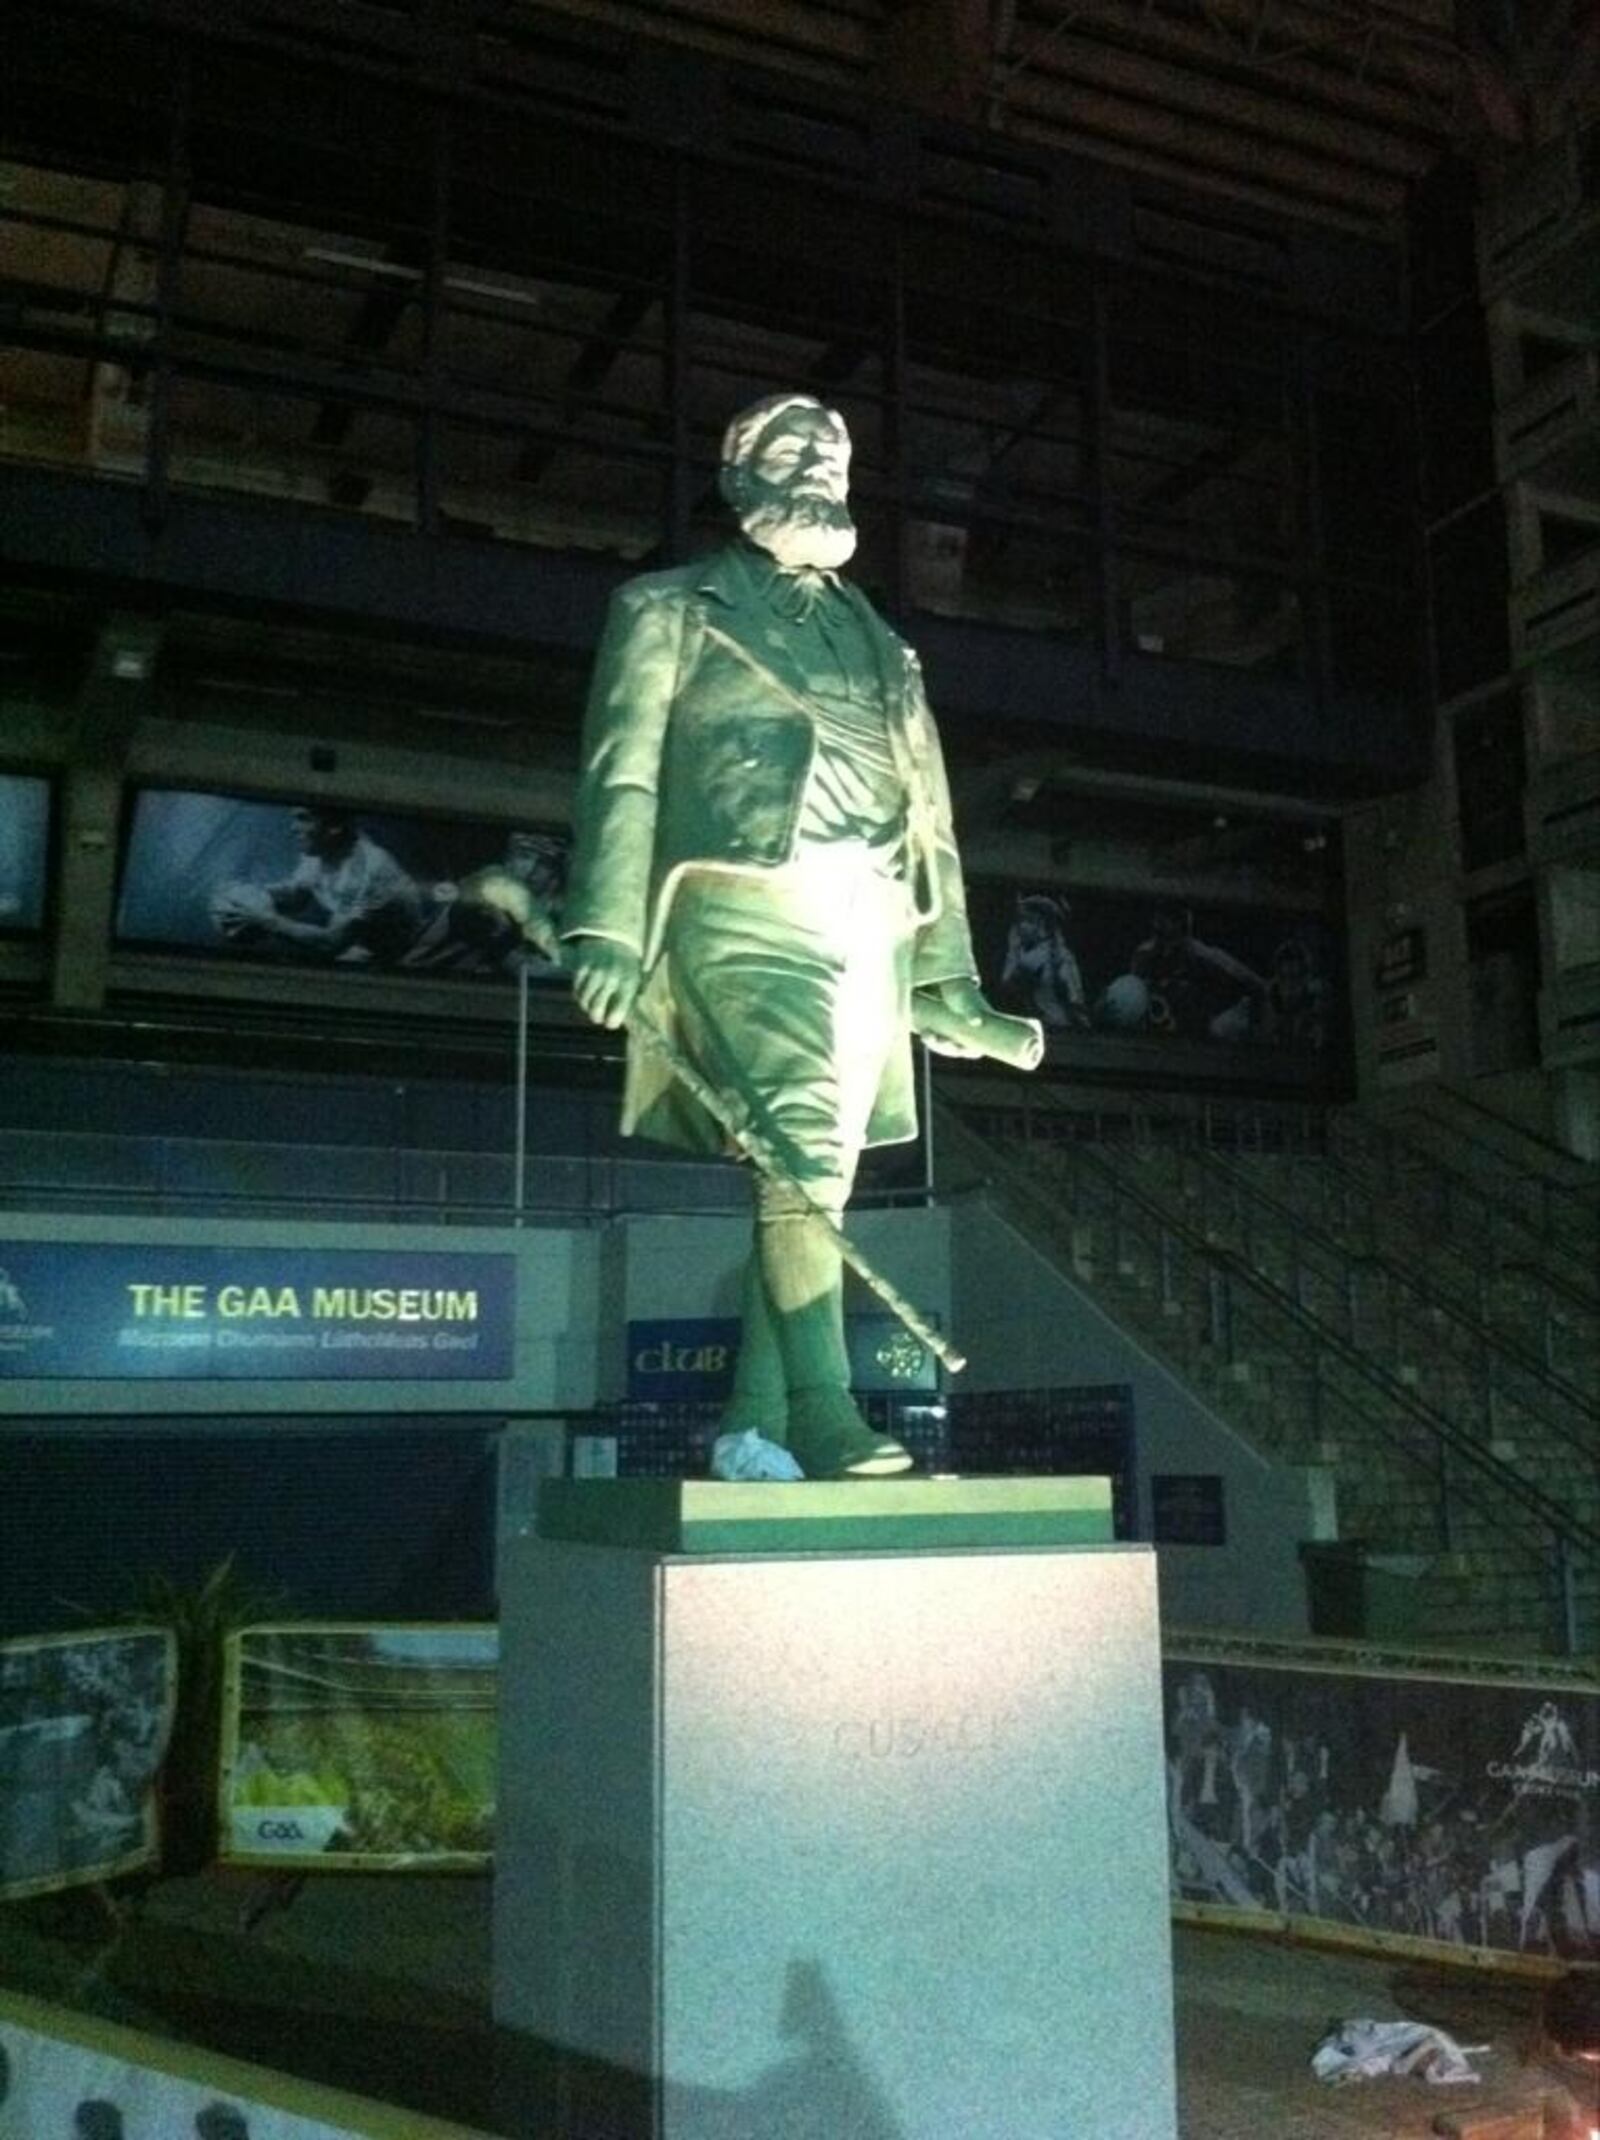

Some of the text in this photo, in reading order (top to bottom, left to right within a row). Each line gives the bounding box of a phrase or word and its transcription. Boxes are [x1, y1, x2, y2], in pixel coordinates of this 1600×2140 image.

[128, 1284, 478, 1320] THE GAA MUSEUM
